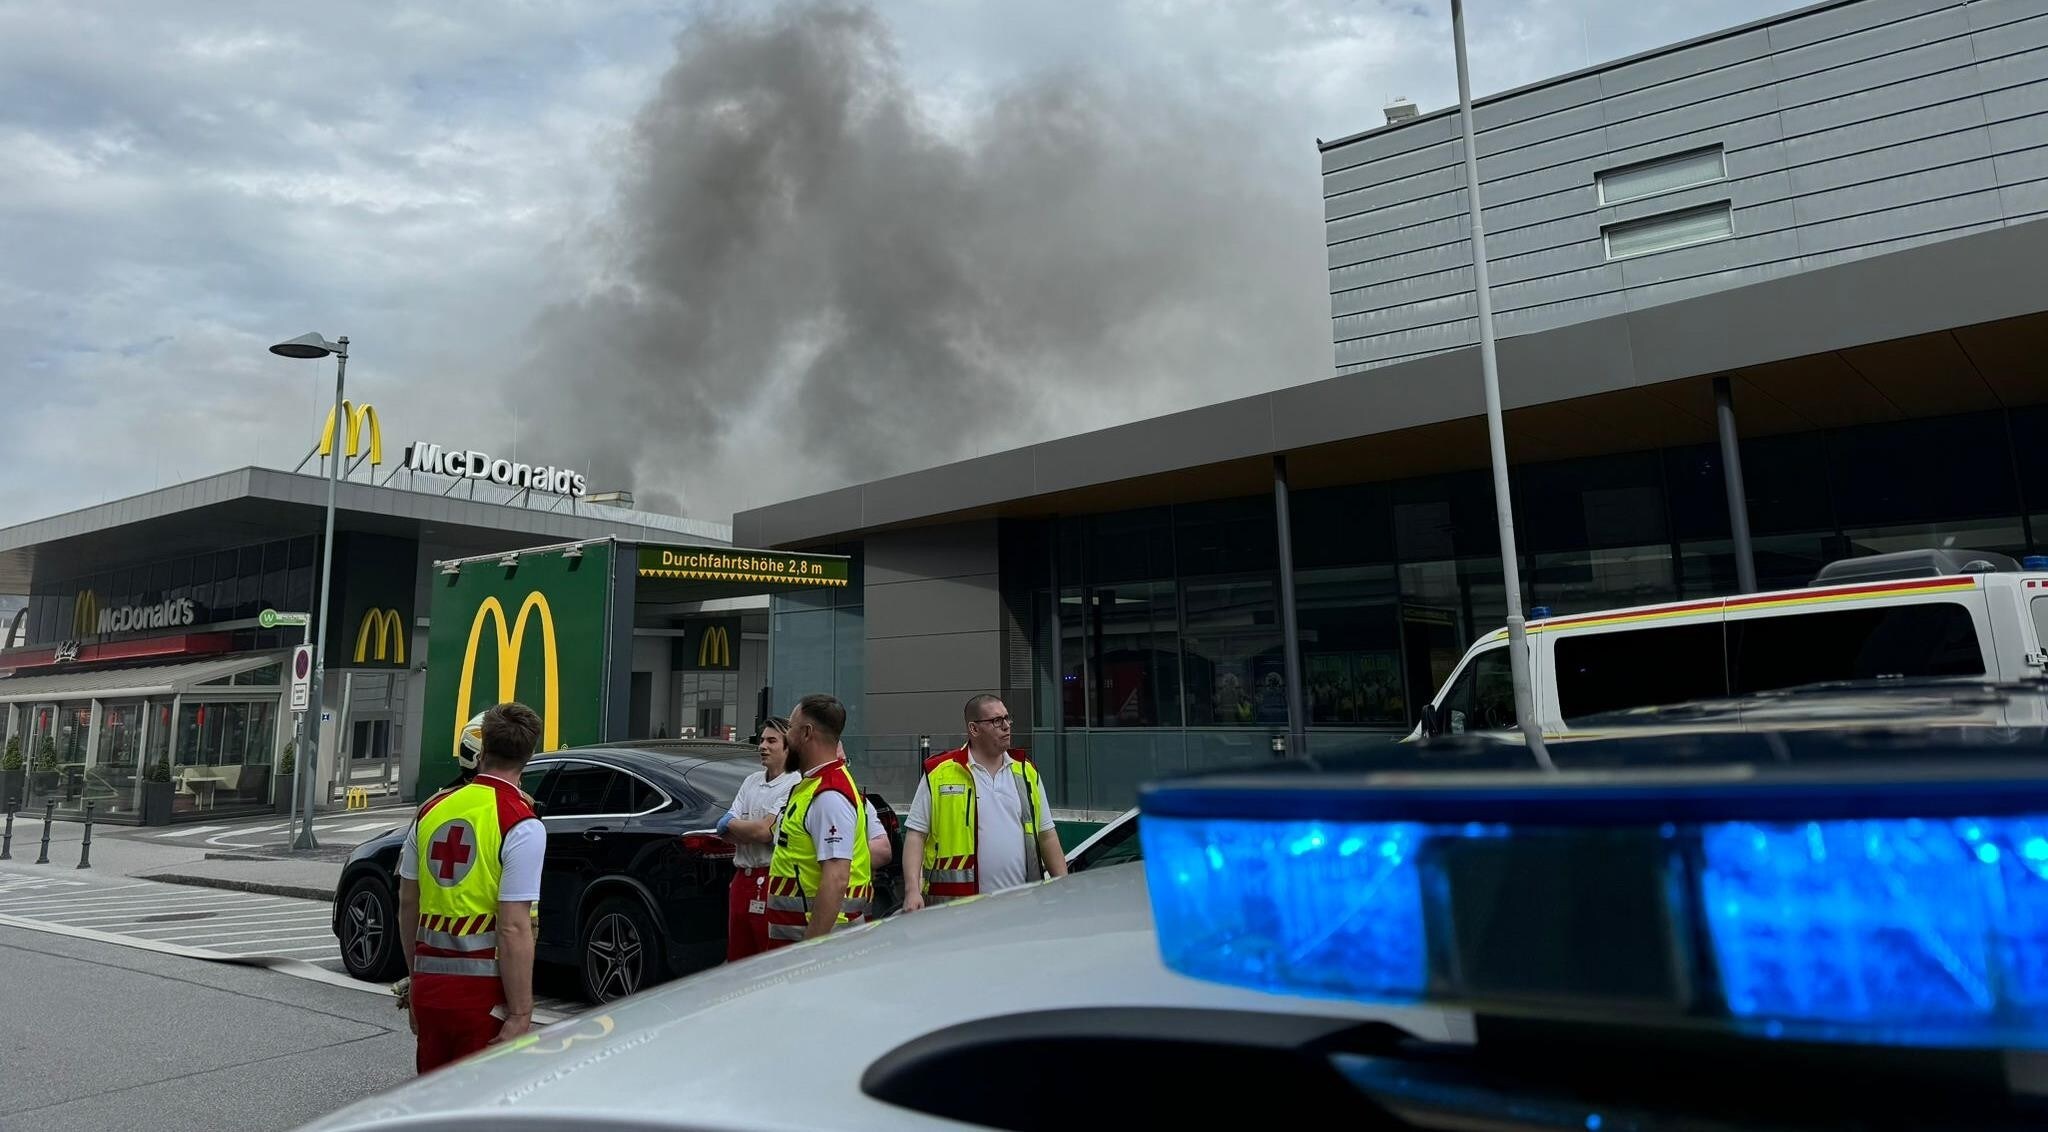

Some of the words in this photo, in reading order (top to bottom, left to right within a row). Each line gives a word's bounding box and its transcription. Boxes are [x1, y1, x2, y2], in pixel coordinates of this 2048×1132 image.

[409, 440, 586, 497] McDonald's
[662, 550, 784, 573] Durchfahrtshöhe
[788, 559, 808, 576] 2,8
[811, 563, 823, 575] m
[96, 597, 195, 635] McDonald's
